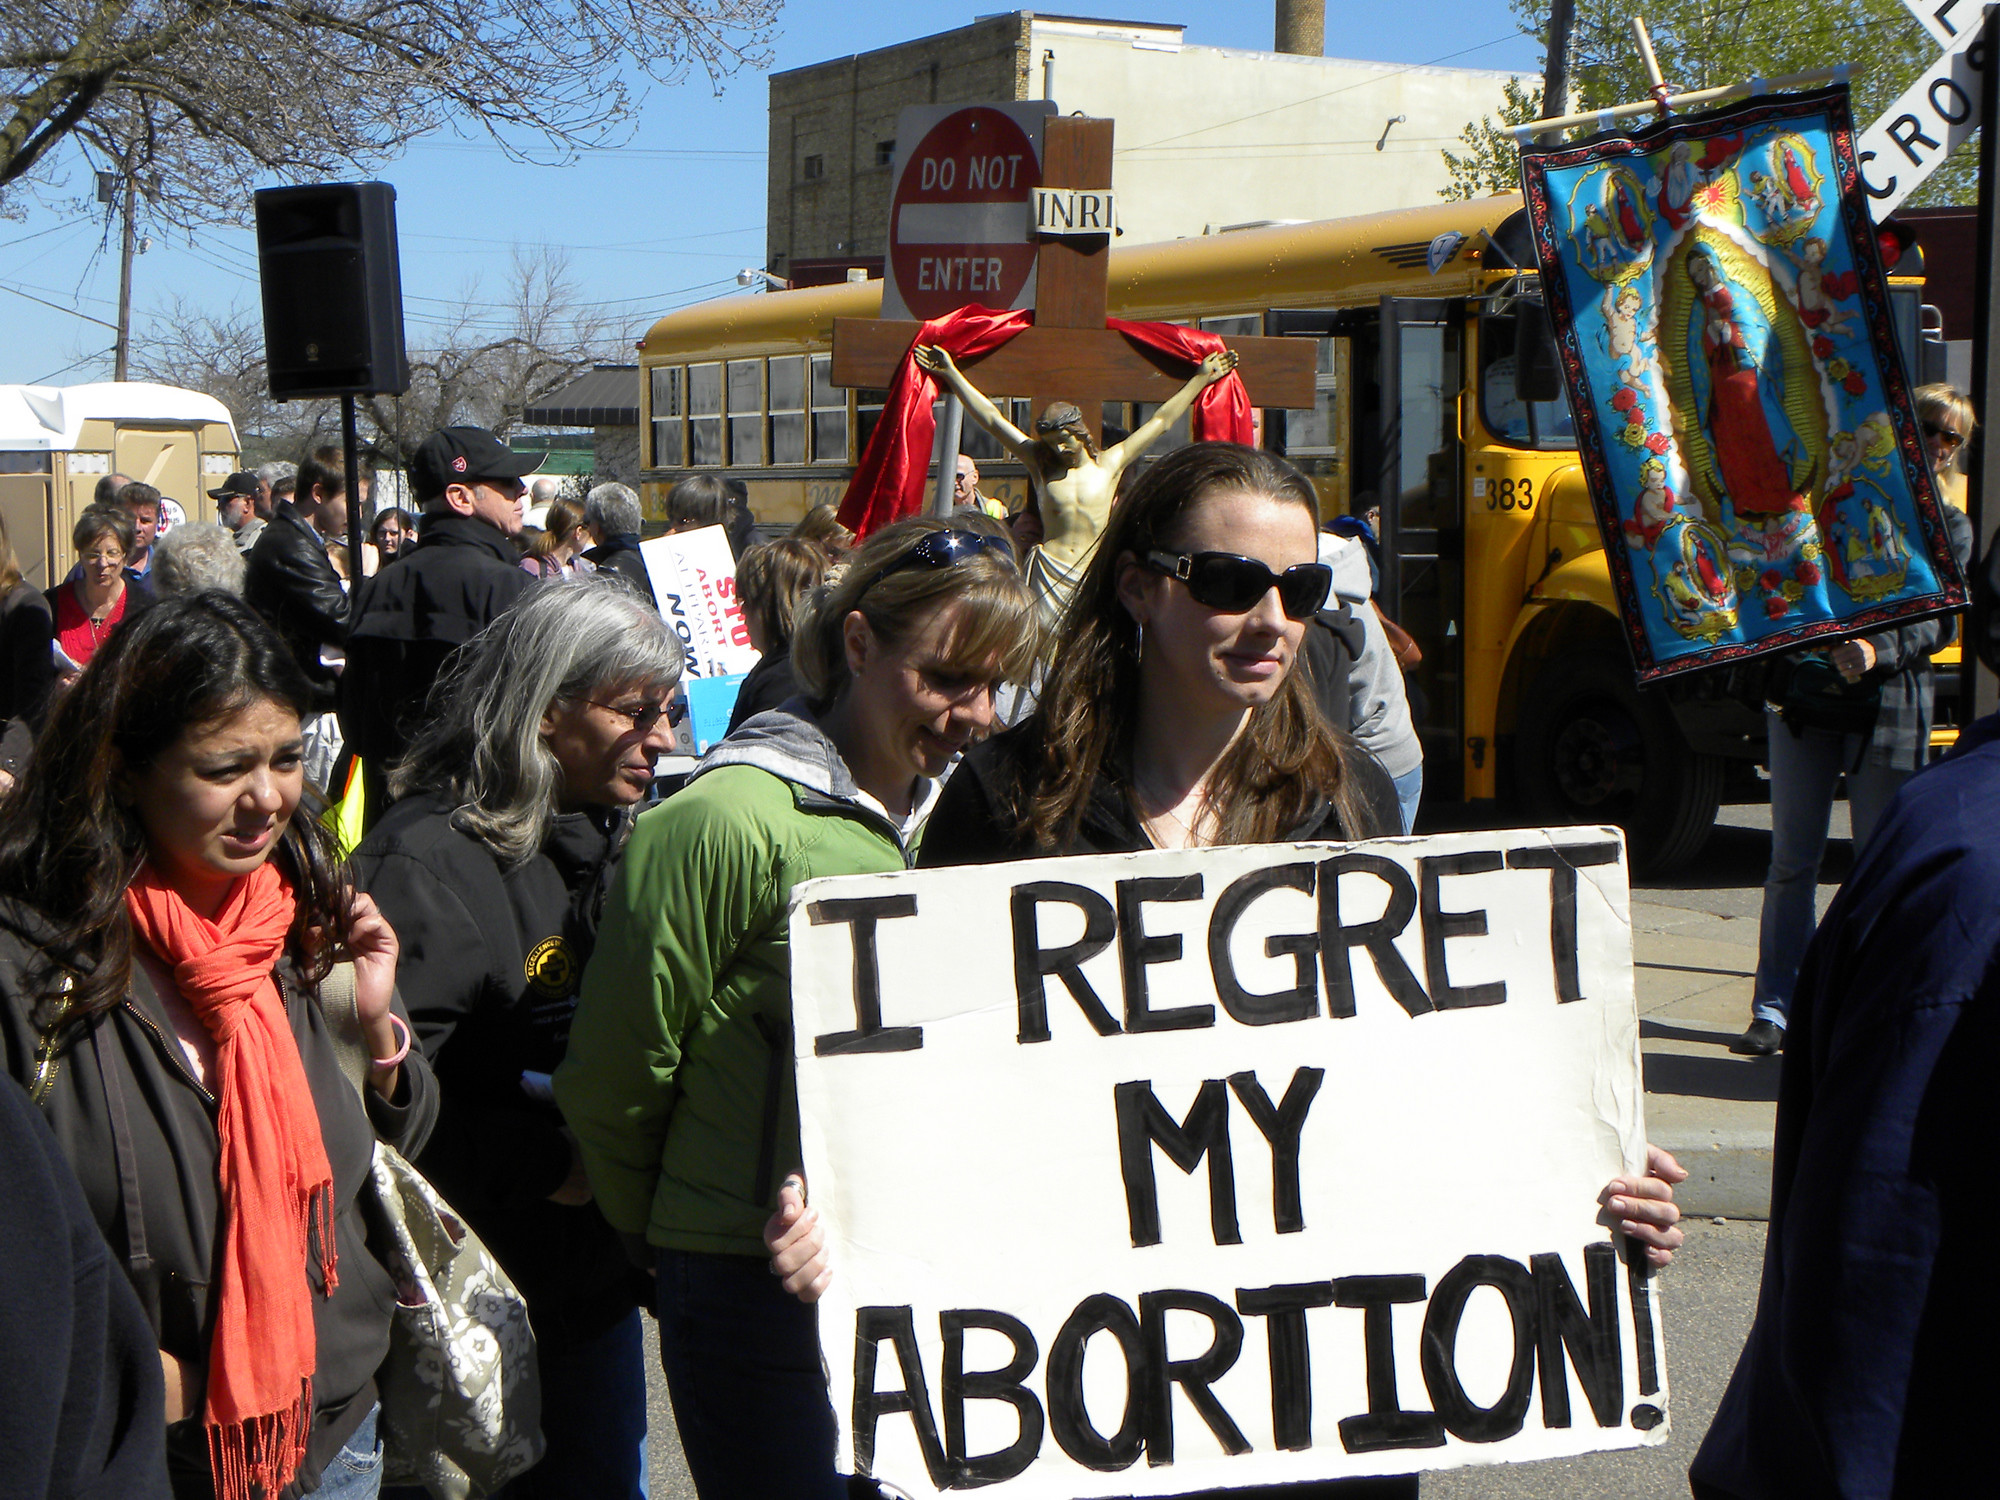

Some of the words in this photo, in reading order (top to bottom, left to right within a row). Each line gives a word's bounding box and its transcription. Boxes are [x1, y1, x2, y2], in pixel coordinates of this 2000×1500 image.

[921, 157, 956, 191] DO
[968, 154, 1023, 190] NOT
[1037, 192, 1113, 229] INRI
[917, 257, 1003, 292] ENTER
[1485, 477, 1533, 512] 383
[666, 592, 701, 679] NOW
[716, 576, 754, 651] STO
[806, 893, 925, 1056] I
[1010, 841, 1621, 1045] REGRET
[1114, 1065, 1326, 1248] MY
[851, 1241, 1667, 1491] ABORTION!
